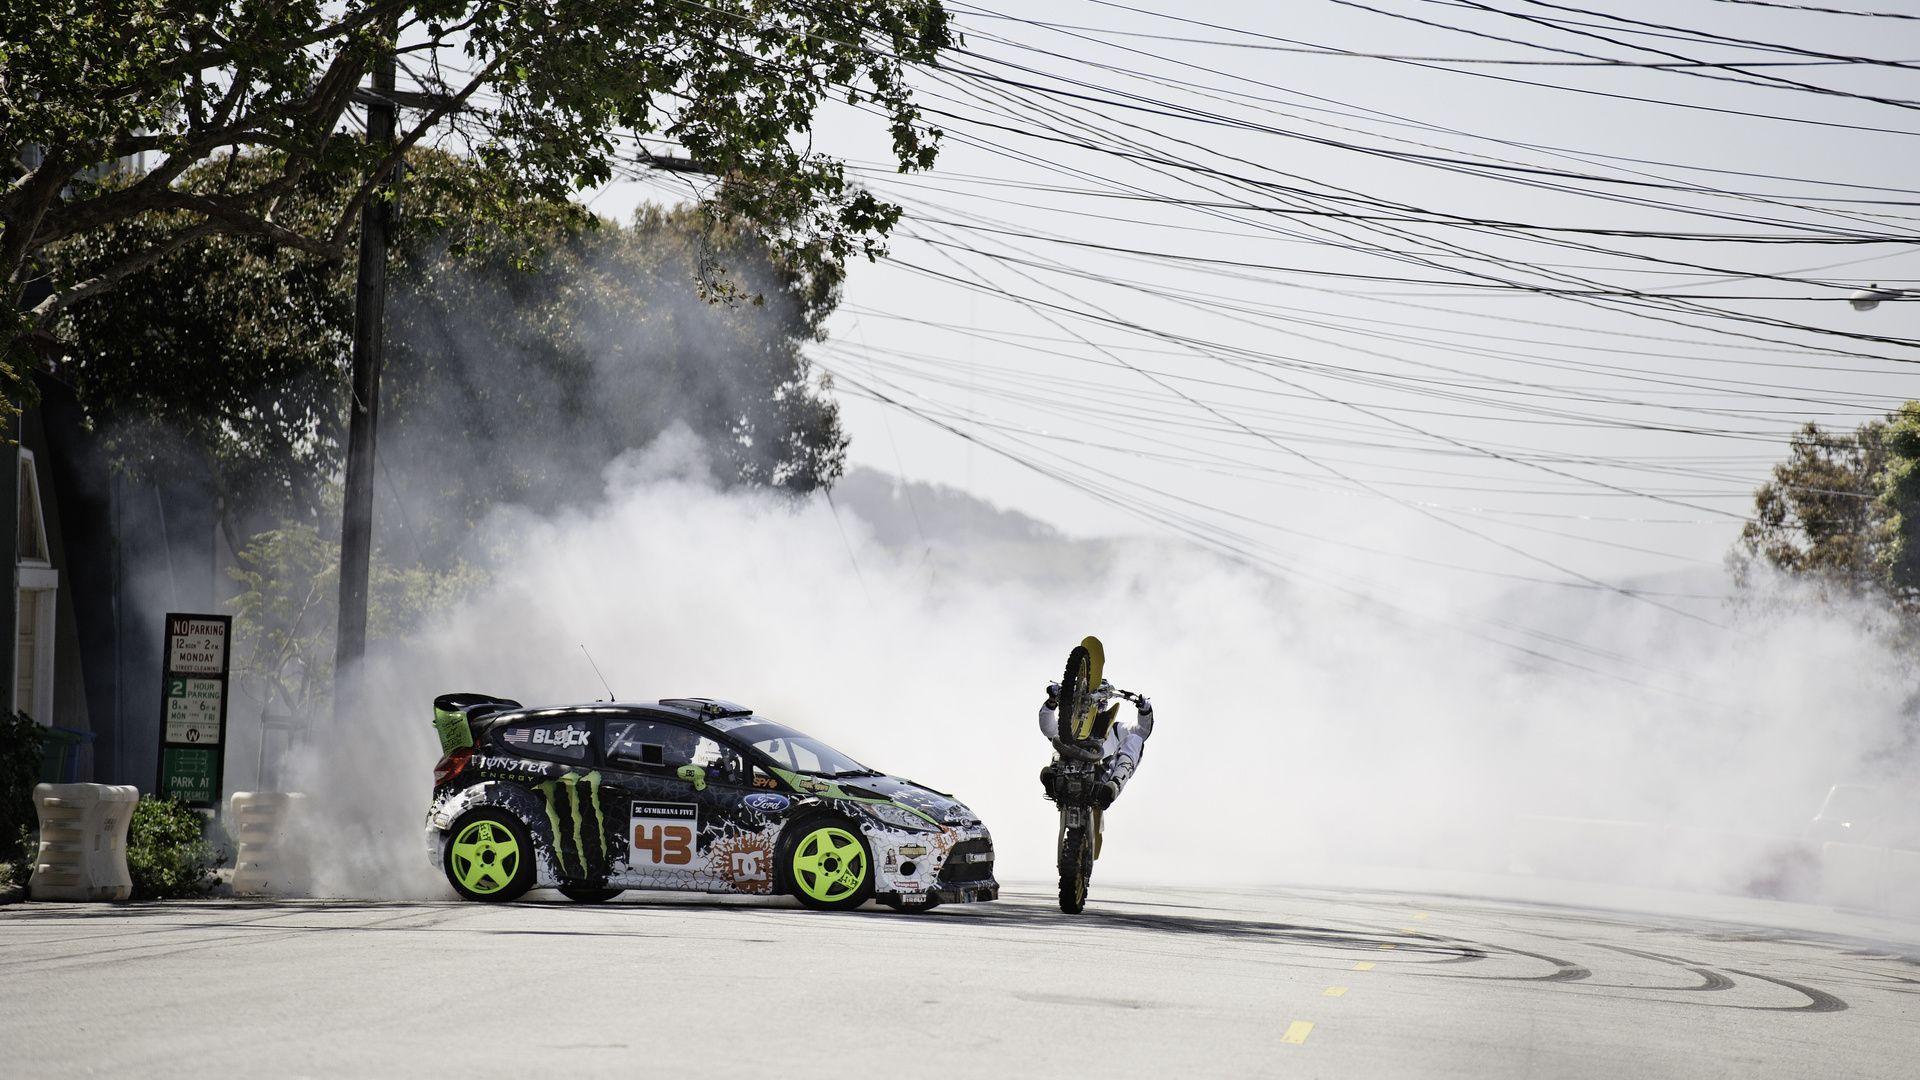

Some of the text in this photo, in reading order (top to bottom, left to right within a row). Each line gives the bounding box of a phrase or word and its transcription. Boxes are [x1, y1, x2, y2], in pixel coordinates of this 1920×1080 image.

[173, 620, 224, 636] NO PARKING
[176, 638, 185, 649] 12
[204, 639, 211, 650] 2
[180, 652, 215, 662] MONDAY
[171, 681, 184, 695] 2
[193, 682, 215, 690] HOUR
[187, 690, 221, 700] PARKING
[171, 700, 178, 710] 8
[200, 700, 206, 711] 6
[171, 712, 186, 720] MON
[187, 730, 199, 741] W
[171, 776, 209, 788] PARK AT
[480, 771, 534, 782] ENERGY
[753, 795, 781, 811] Ford
[644, 807, 678, 815] GYMKHANA
[679, 808, 694, 816] FIVE
[634, 824, 692, 866] 43
[731, 850, 767, 883] DC
